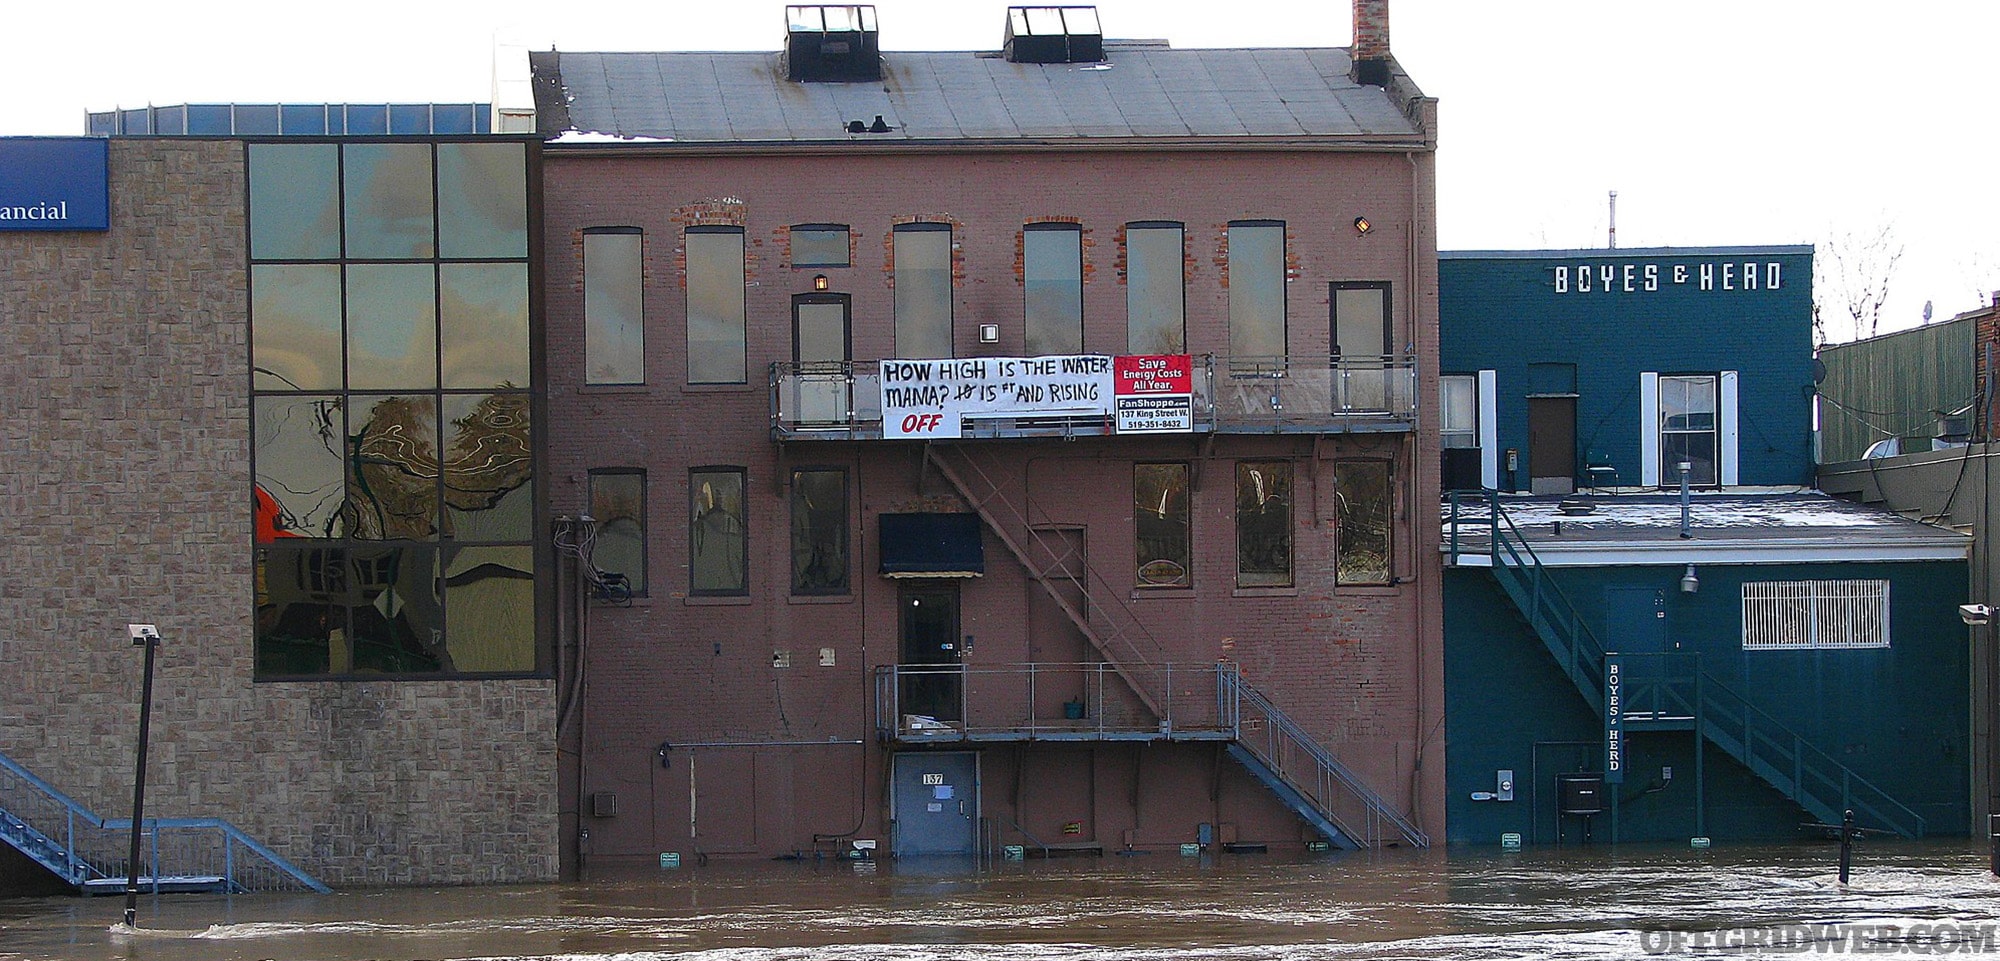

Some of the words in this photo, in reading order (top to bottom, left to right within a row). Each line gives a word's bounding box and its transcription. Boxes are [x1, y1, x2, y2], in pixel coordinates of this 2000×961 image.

[1555, 265, 1657, 293] BOYES
[1674, 265, 1689, 283] &
[884, 363, 932, 381] HOW
[940, 361, 986, 380] HIGH
[999, 361, 1015, 377] IS
[1020, 360, 1055, 375] THE
[1062, 357, 1108, 374] WATER
[1139, 358, 1167, 369] Save
[1123, 370, 1156, 380] Energy
[1157, 369, 1182, 378] Costs
[1133, 381, 1146, 390] All
[1148, 381, 1173, 390] Year.
[886, 384, 949, 409] MAMA?
[981, 385, 997, 402] 15
[1016, 384, 1044, 402] AND
[1049, 383, 1098, 402] RISING
[901, 414, 943, 433] OFF
[1136, 410, 1154, 419] King
[1155, 409, 1178, 417] Street
[1179, 409, 1188, 417] W.
[1609, 664, 1619, 716] BOYES
[1609, 730, 1619, 771] HERD
[925, 775, 942, 783] 137
